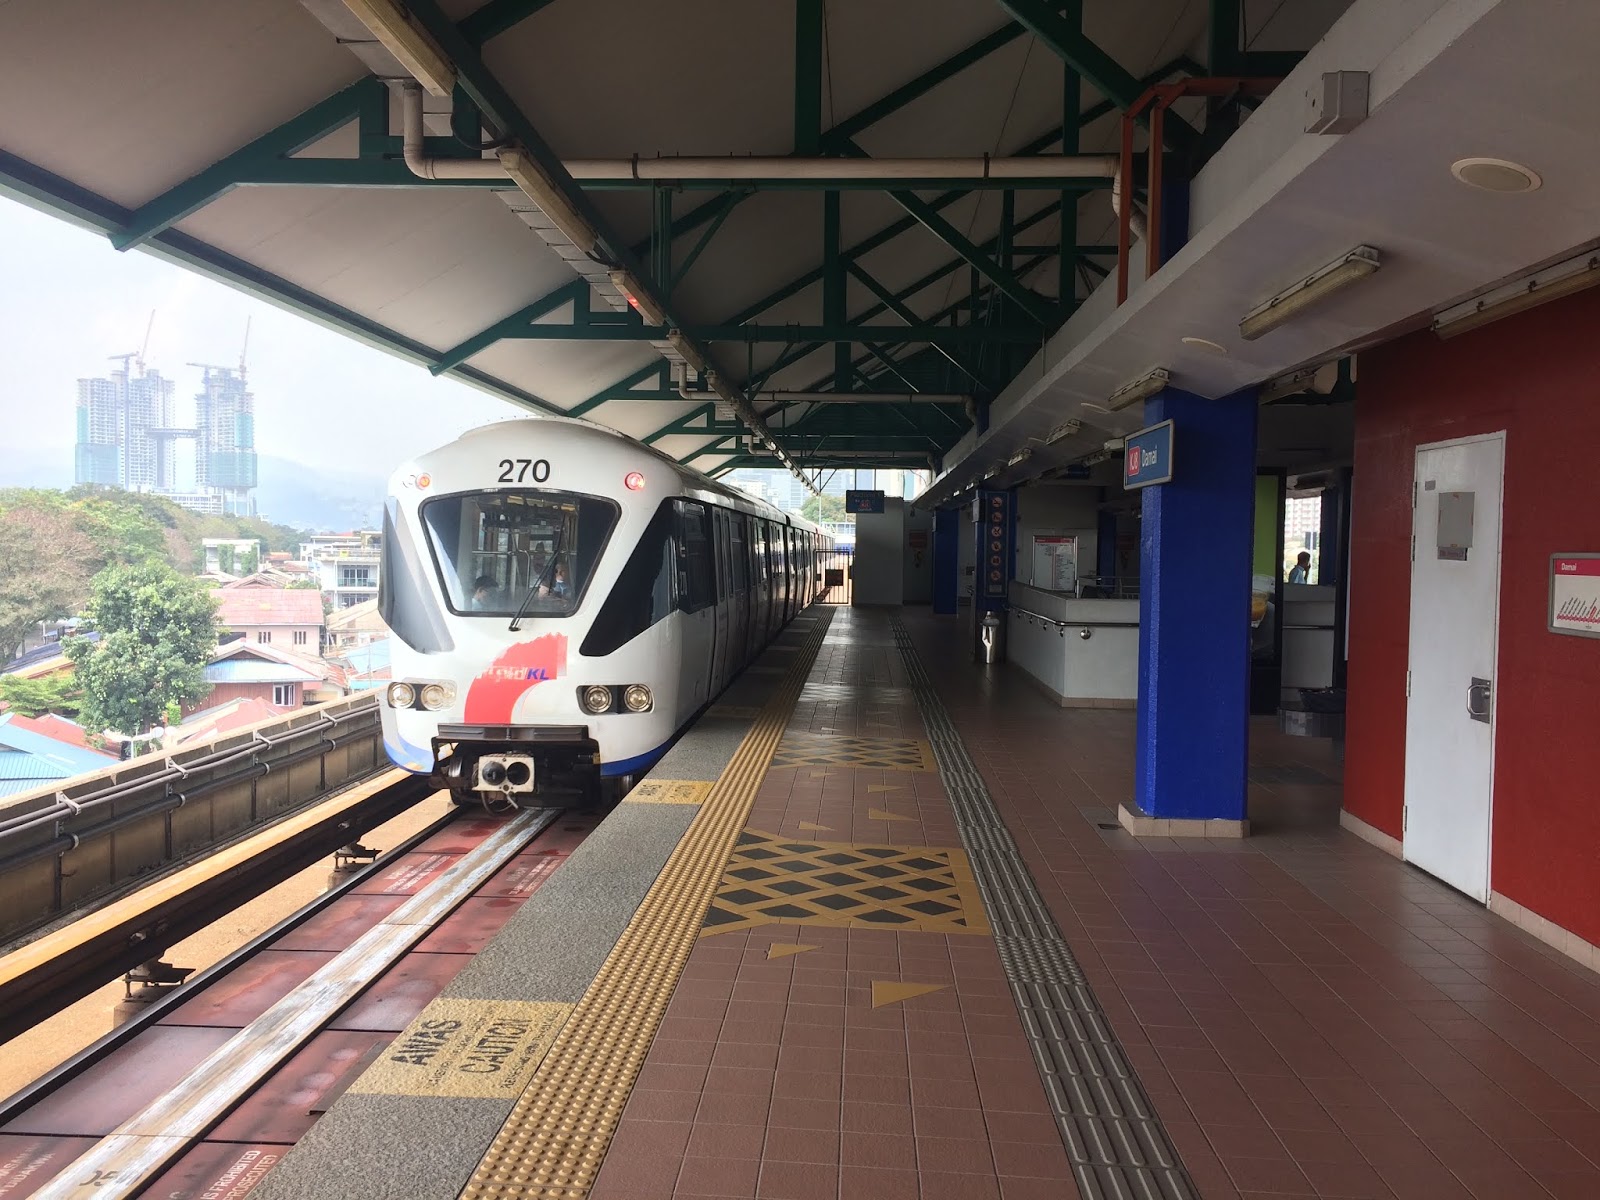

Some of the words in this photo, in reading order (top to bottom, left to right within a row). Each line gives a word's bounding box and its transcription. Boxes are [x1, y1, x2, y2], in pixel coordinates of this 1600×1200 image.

[1142, 445, 1157, 467] Damai
[498, 459, 551, 483] 270
[1561, 563, 1577, 571] Damai
[390, 1019, 462, 1067] AWAS
[459, 1018, 532, 1074] CAUTION
